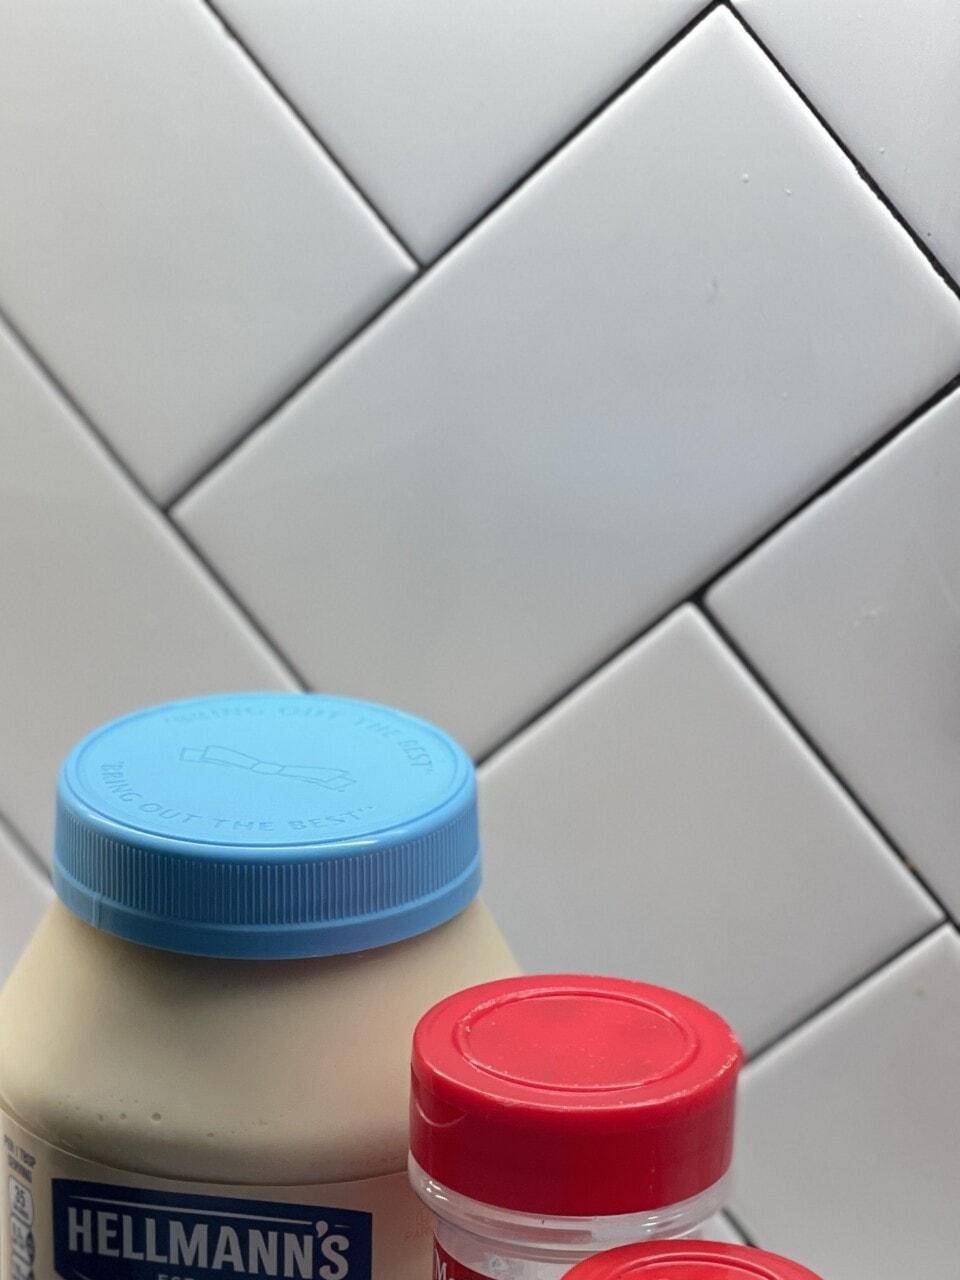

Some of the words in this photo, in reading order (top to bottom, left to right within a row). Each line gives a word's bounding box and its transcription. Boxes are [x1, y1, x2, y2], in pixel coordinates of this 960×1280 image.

[139, 801, 203, 825] OUT
[212, 817, 276, 831] THE
[14, 1184, 26, 1208] 35
